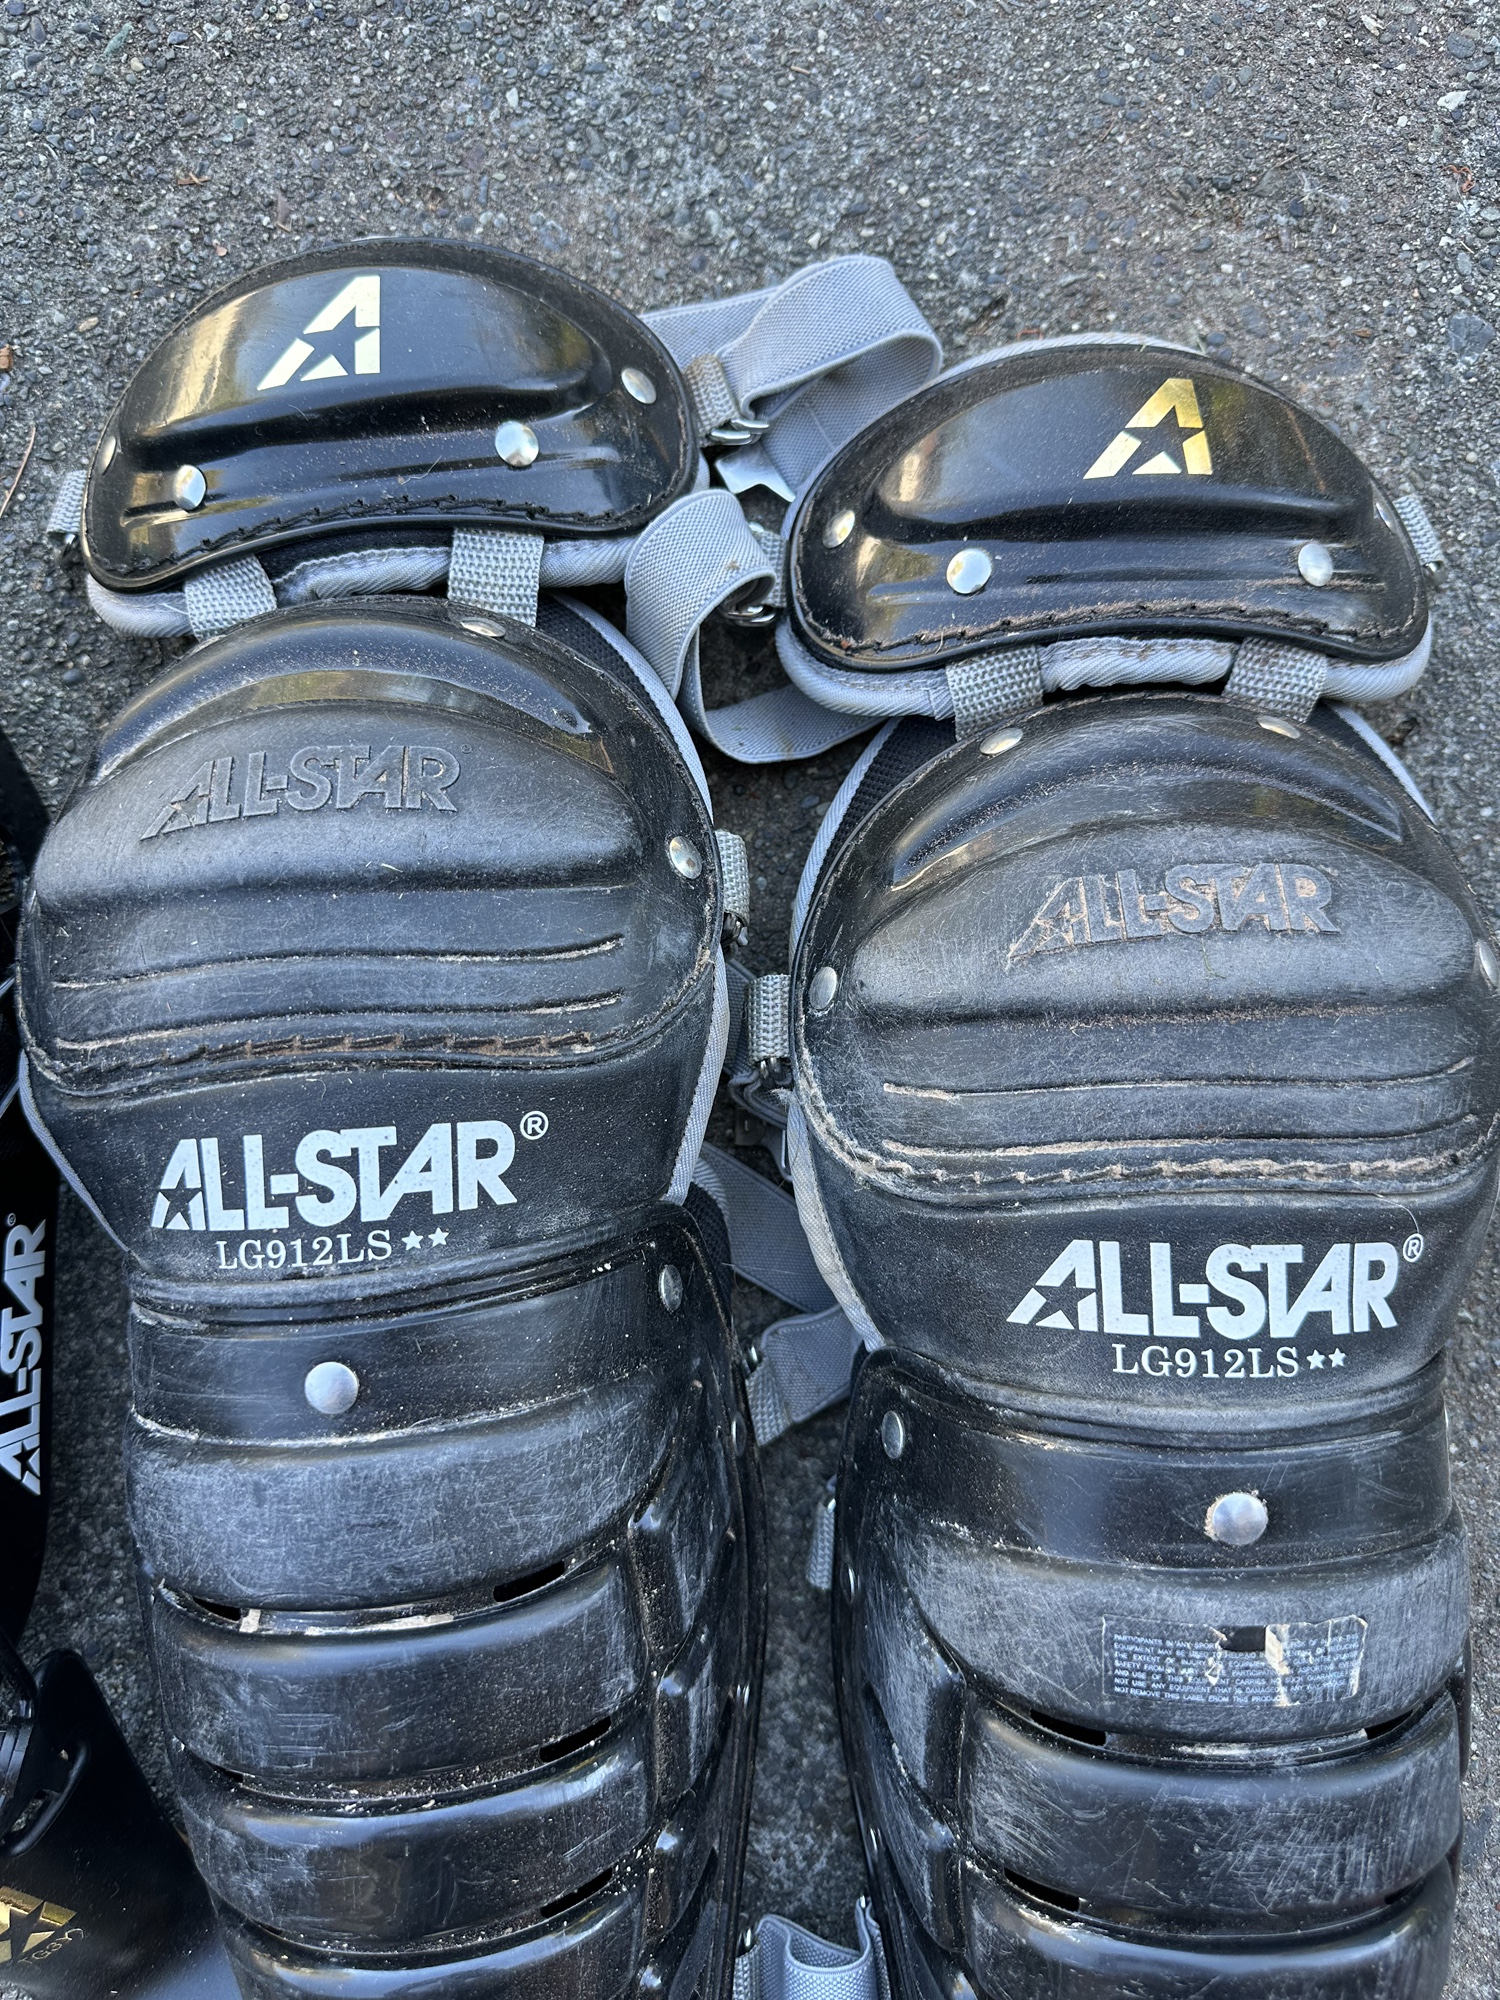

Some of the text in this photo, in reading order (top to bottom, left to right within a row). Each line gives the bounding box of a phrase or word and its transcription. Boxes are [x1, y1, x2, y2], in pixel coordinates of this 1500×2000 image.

[217, 1229, 393, 1270] LG912LS
[1112, 1343, 1299, 1378] LG912LS
[1114, 1642, 1154, 1653] EQUIPMENT
[1115, 1651, 1127, 1659] THE
[1133, 1654, 1160, 1663] EXTENT
[1114, 1660, 1141, 1669] SAFETY
[1144, 1664, 1164, 1672] FROM
[1114, 1677, 1129, 1685] NOT
[1132, 1680, 1146, 1688] USE
[1169, 1684, 1211, 1693] EQUIPMENT
[1215, 1686, 1232, 1694] THAT
[1114, 1686, 1129, 1694] NOT
[1130, 1688, 1161, 1698] REMOVE
[1183, 1694, 1205, 1702] LABEL
[1208, 1695, 1229, 1703] FROM
[1252, 1694, 1281, 1703] PRODUC
